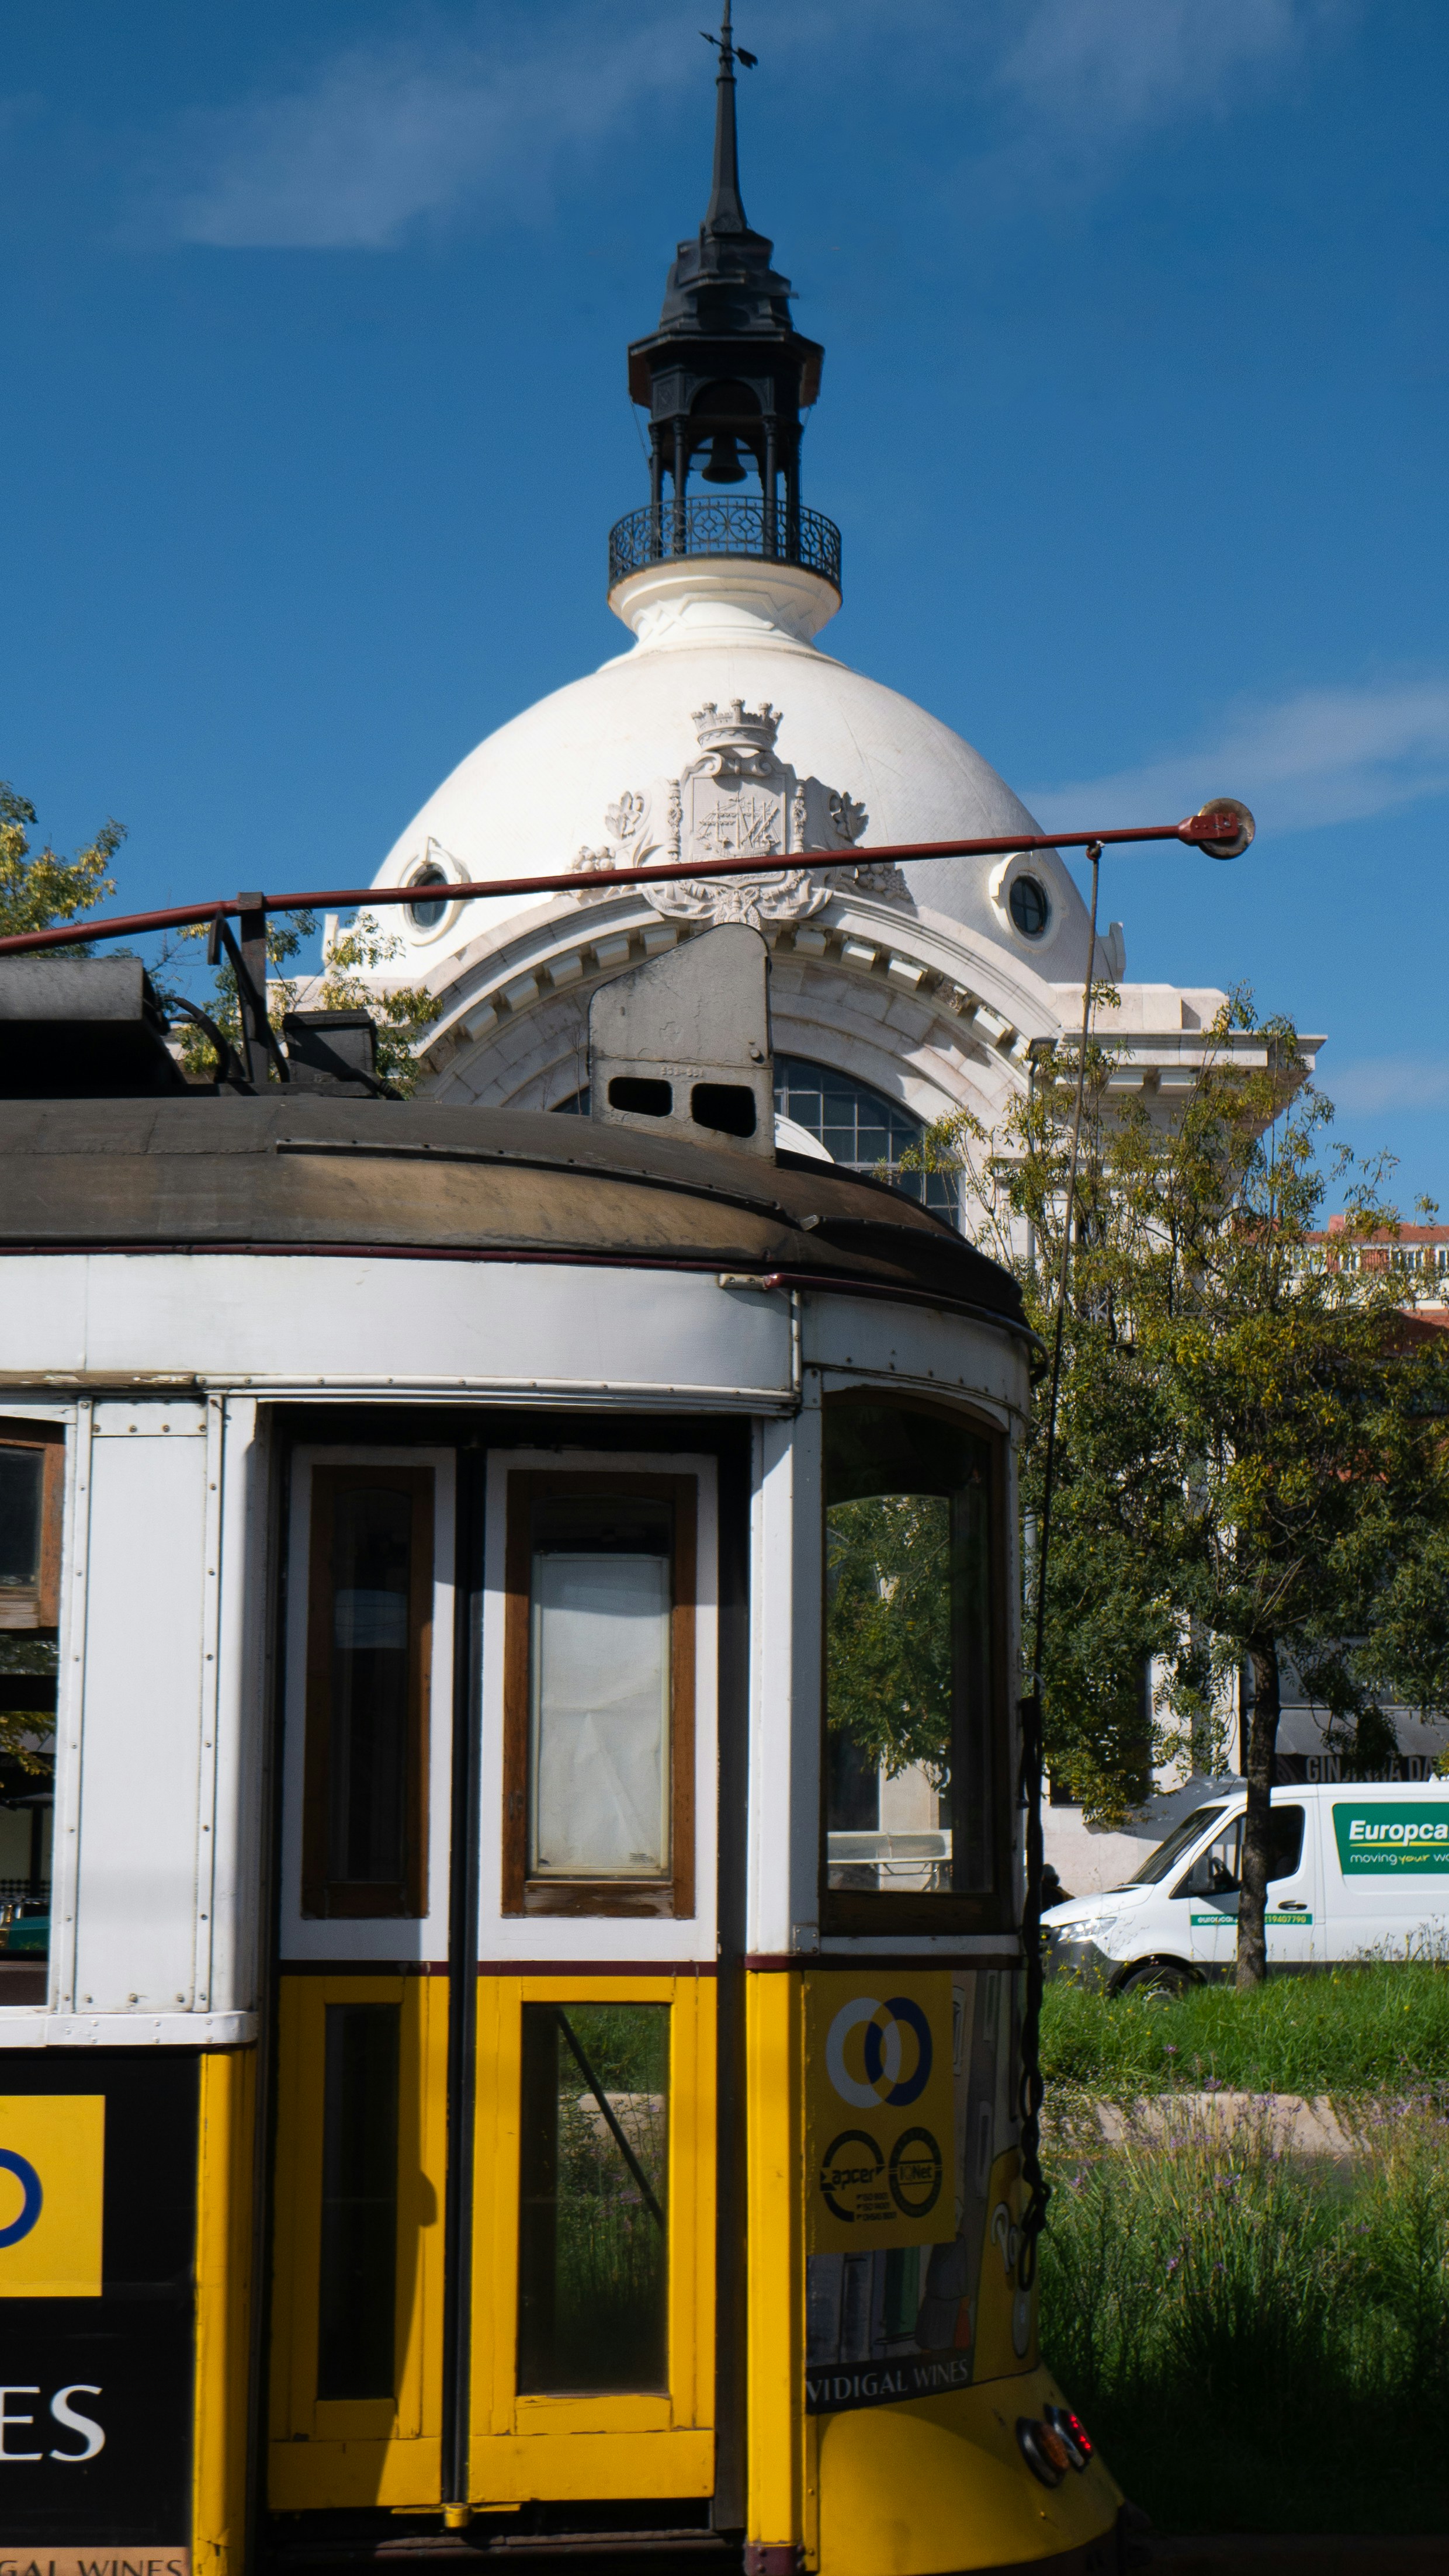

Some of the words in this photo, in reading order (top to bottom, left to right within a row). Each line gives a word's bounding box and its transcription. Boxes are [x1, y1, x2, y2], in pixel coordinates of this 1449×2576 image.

[1350, 1853, 1398, 1866] moving
[1398, 1854, 1430, 1865] your
[832, 2168, 875, 2190] apcer
[806, 2370, 907, 2403] VIDIGAL
[912, 2359, 968, 2388] WINES
[77, 2560, 182, 2576] WINES
